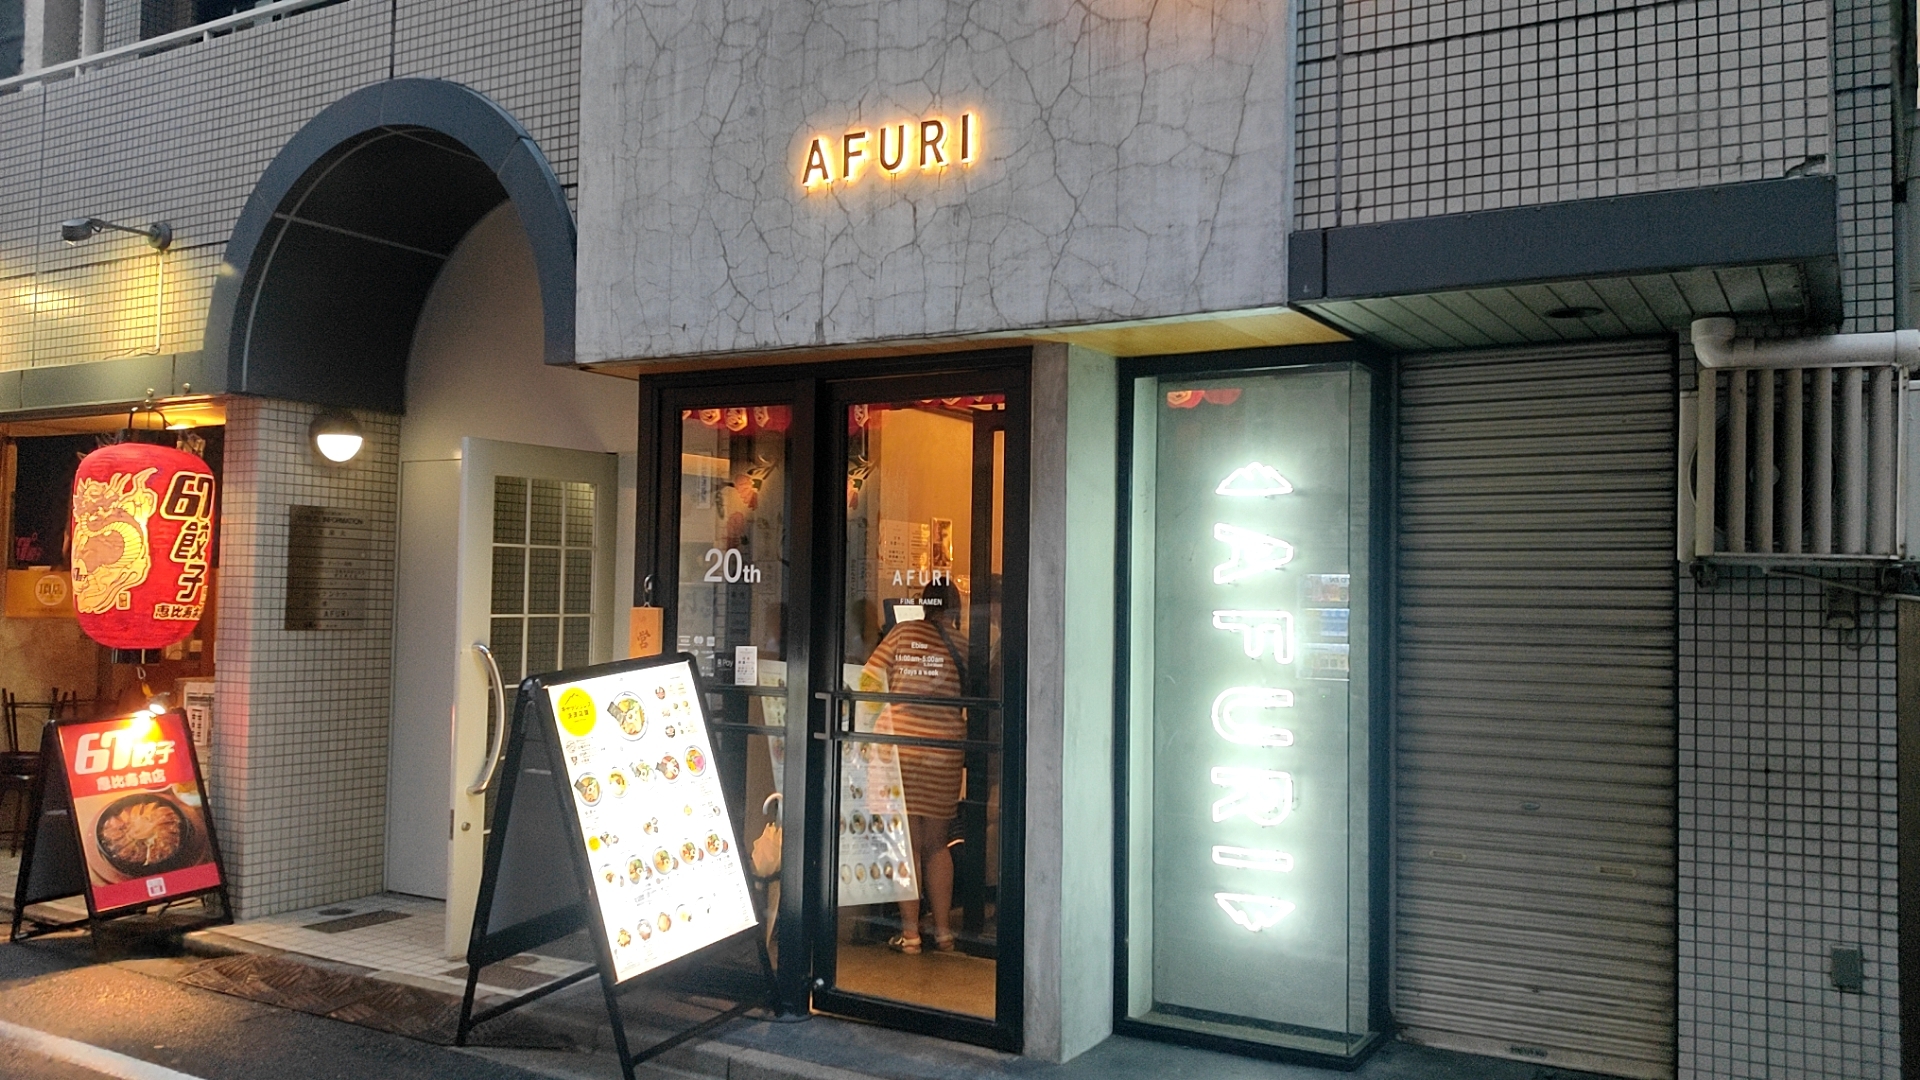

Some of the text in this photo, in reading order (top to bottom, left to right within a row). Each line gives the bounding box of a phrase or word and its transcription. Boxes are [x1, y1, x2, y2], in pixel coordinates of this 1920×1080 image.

[802, 113, 971, 186] AFURI
[322, 517, 363, 525] INFORMATION
[704, 548, 761, 583] 20th
[892, 569, 950, 586] AFURI
[900, 597, 942, 606] FINE RAMEN
[911, 641, 928, 650] Ebisu
[1211, 522, 1294, 872] AFURI
